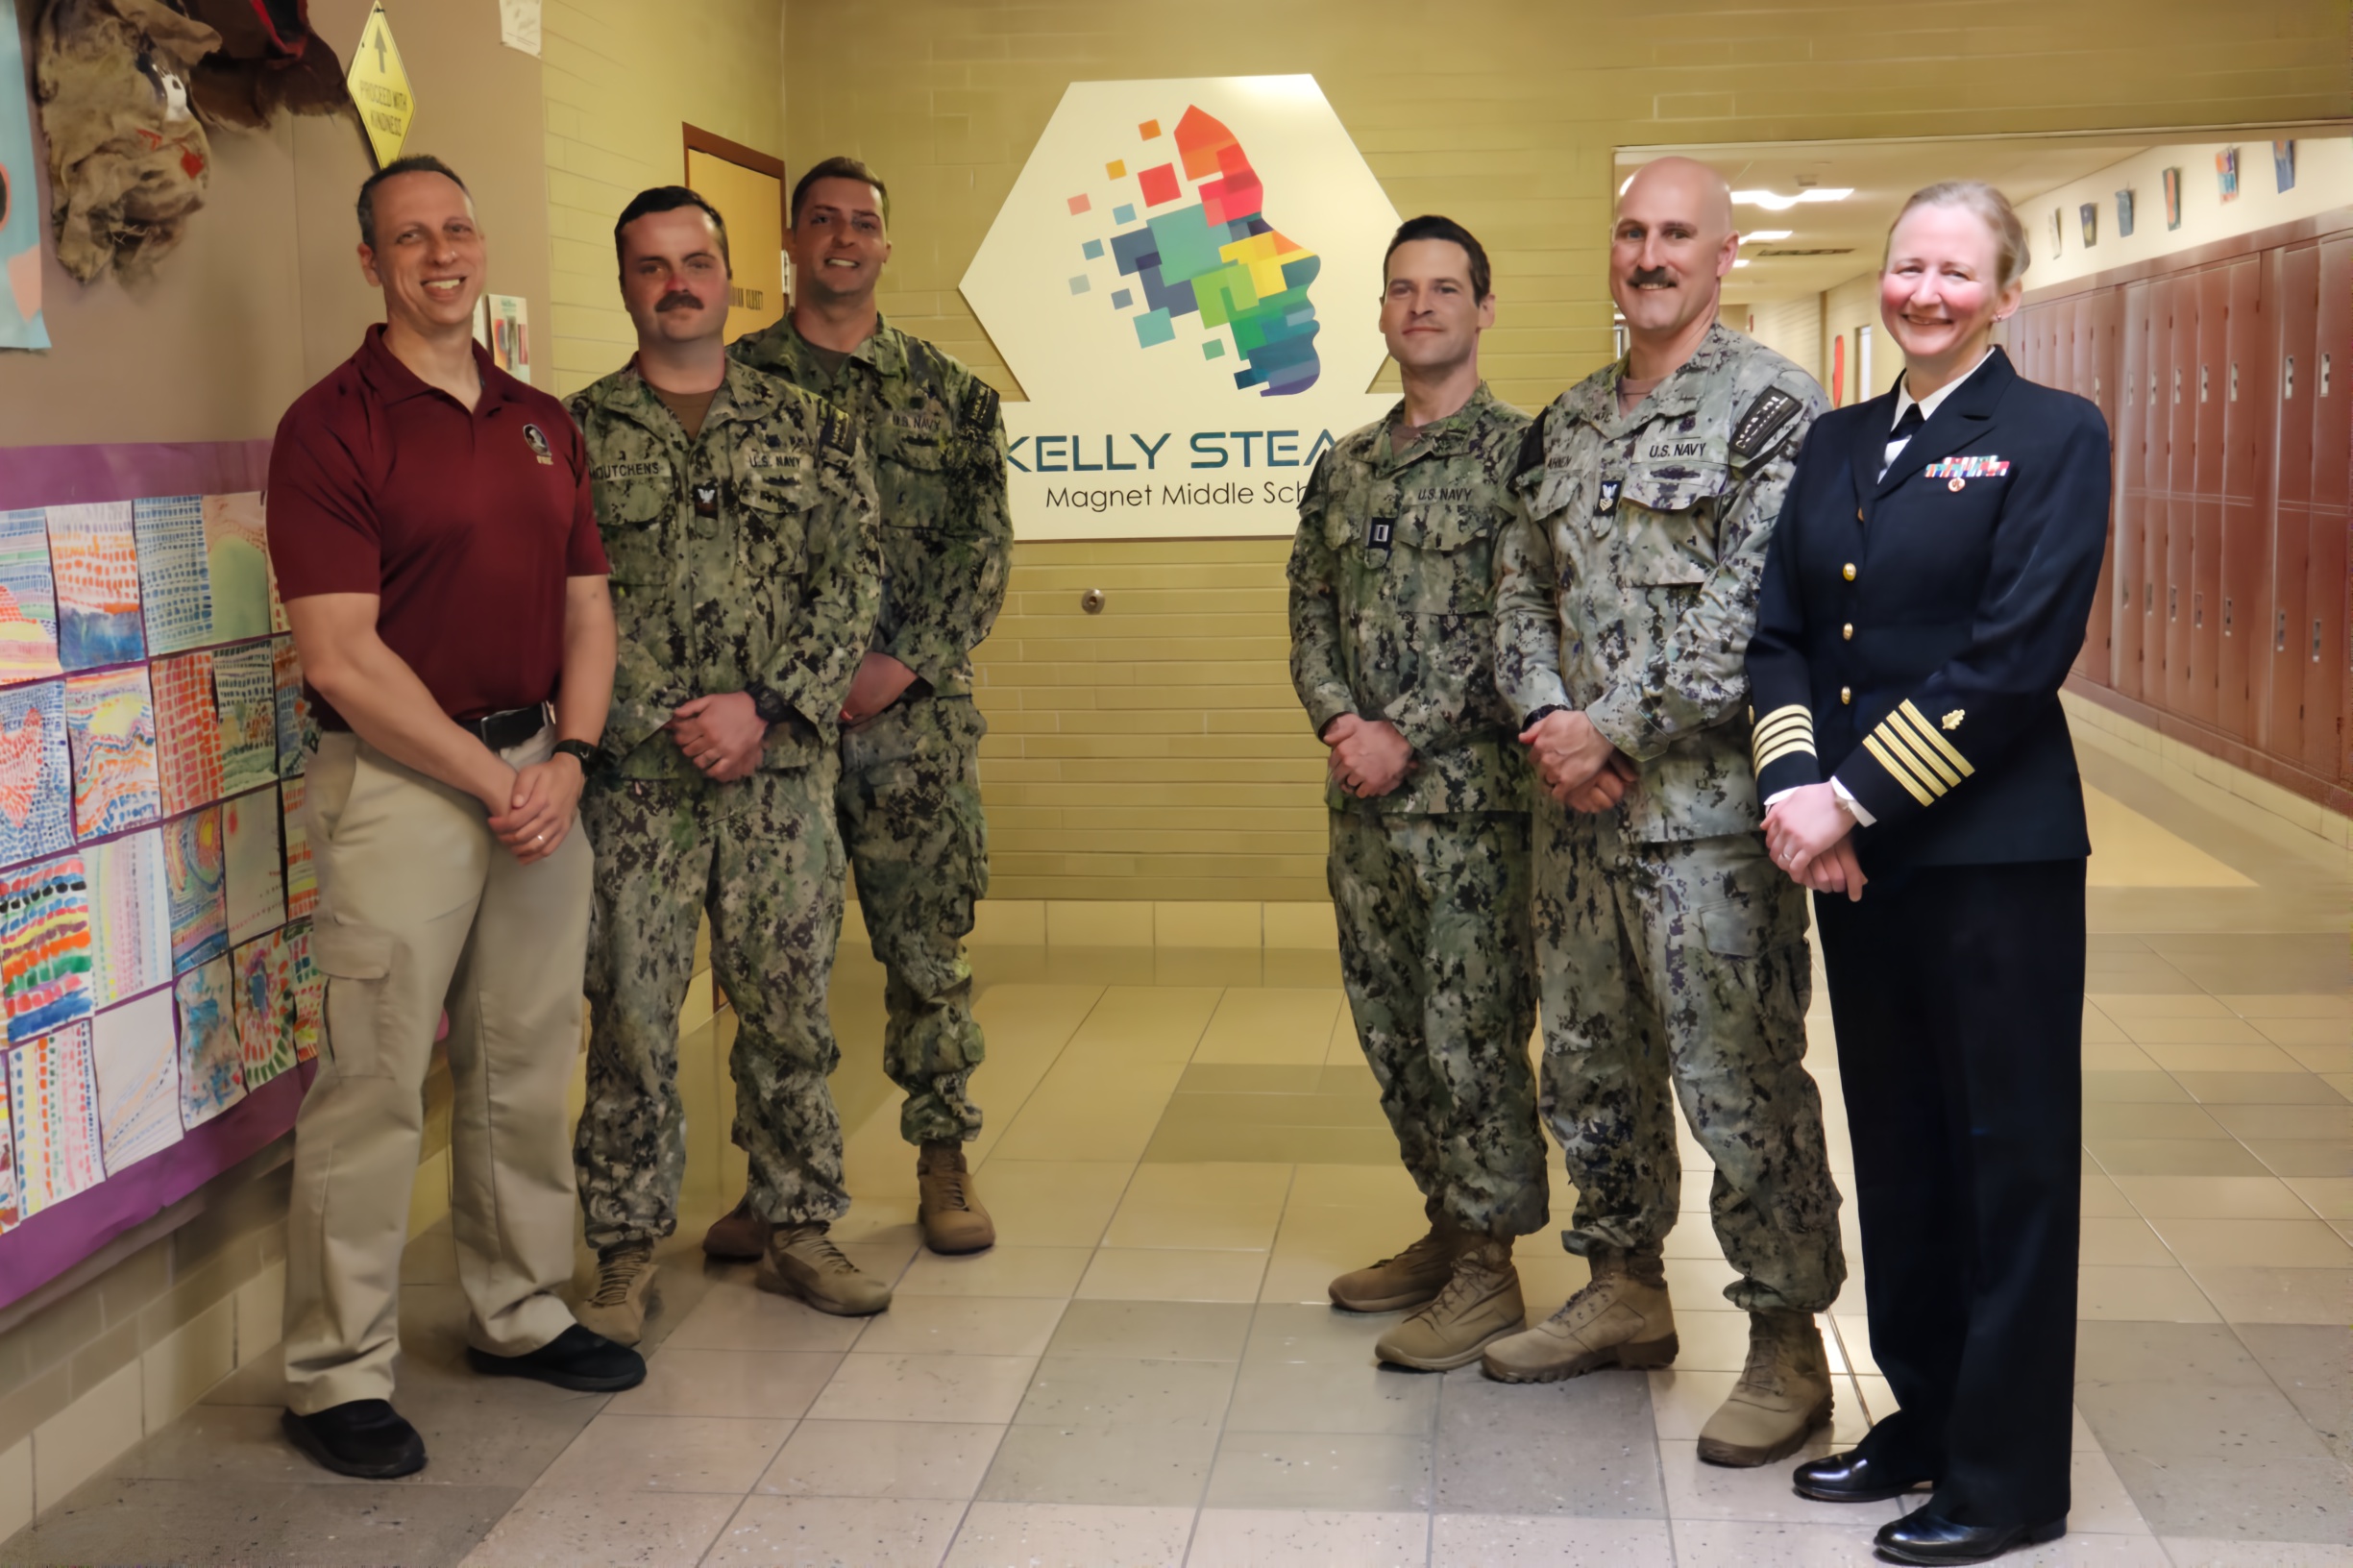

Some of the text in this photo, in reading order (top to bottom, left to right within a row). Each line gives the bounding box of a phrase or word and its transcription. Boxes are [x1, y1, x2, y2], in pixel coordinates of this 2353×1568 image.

[359, 80, 407, 111] PROCEED WITH
[370, 110, 402, 136] KINDNESS
[914, 414, 942, 431] NAVY
[1007, 429, 1336, 473] KELLY STEA
[1649, 442, 1707, 458] U.S. NAVY
[748, 454, 801, 468] U.S. NAVY
[1046, 484, 1153, 513] Magnet
[1163, 481, 1255, 505] Middle
[1263, 480, 1308, 504] Sch
[1417, 487, 1473, 502] U.S. NAVY
